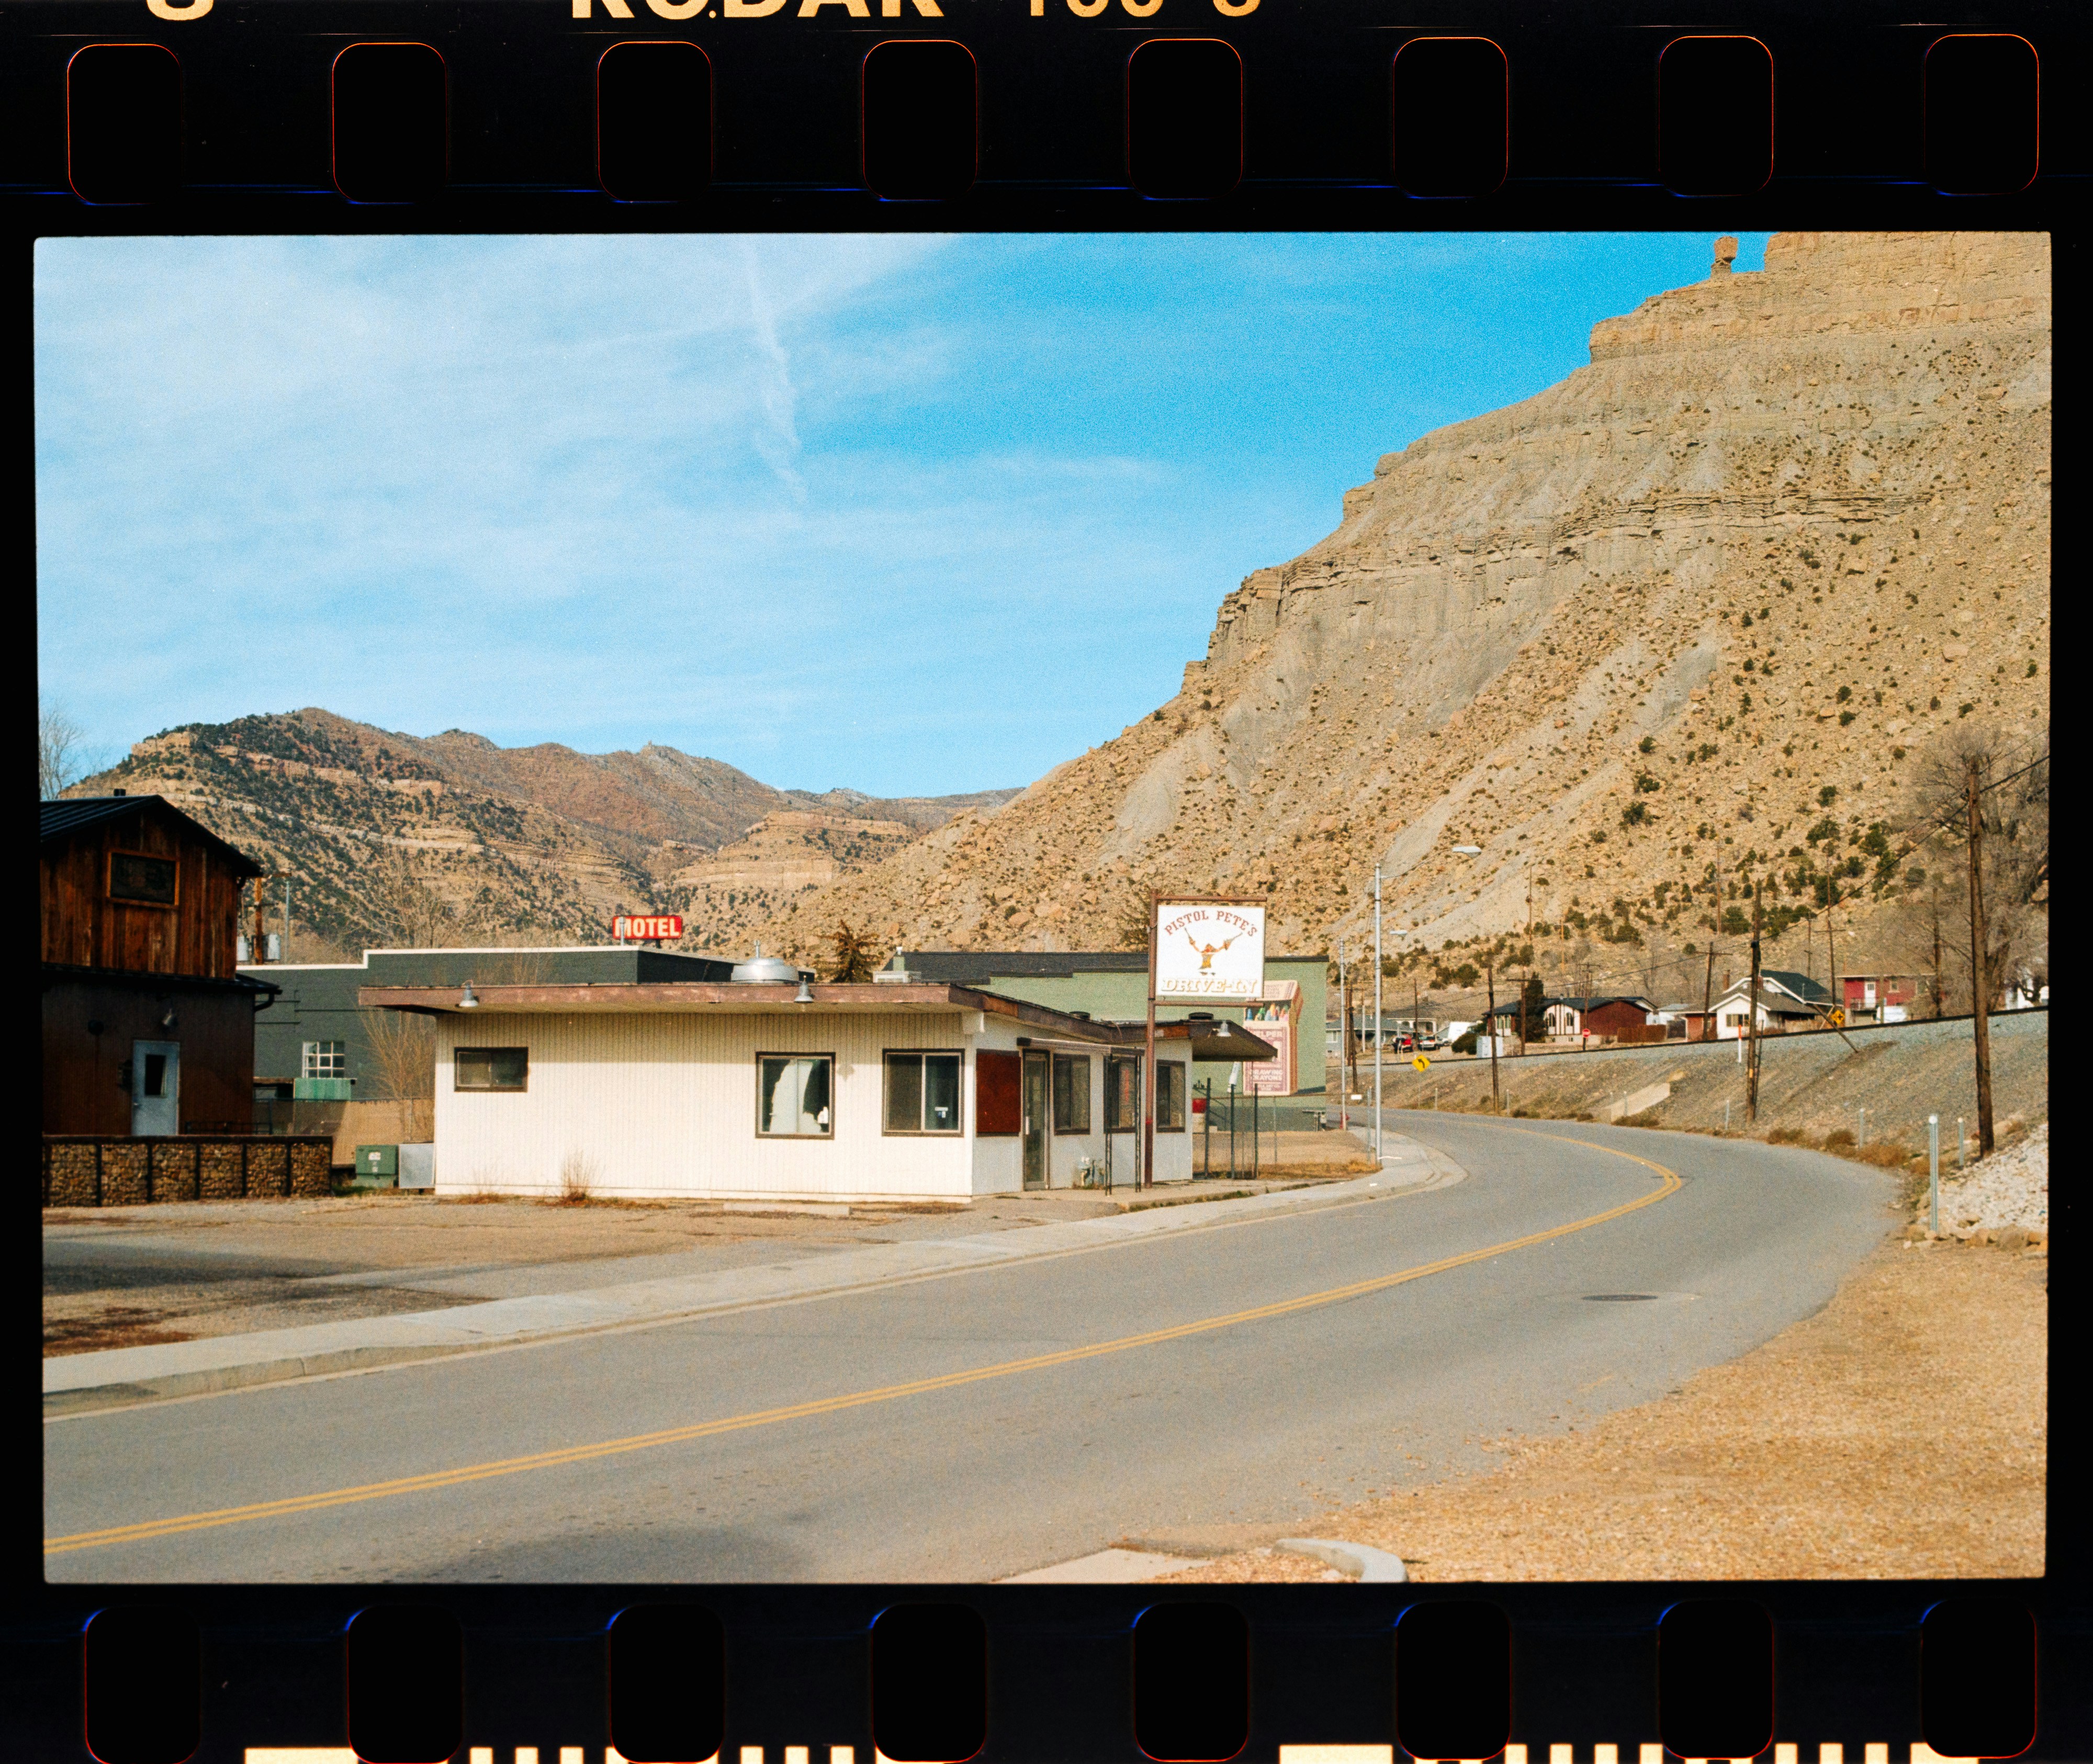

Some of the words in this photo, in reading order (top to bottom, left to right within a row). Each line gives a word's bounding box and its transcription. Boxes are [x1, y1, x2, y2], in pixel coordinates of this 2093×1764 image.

[615, 918, 680, 937] MOTEL
[1164, 910, 1209, 936] PISTOL
[1216, 910, 1258, 936] PETE'S
[1161, 978, 1258, 993] DRIVE-IN
